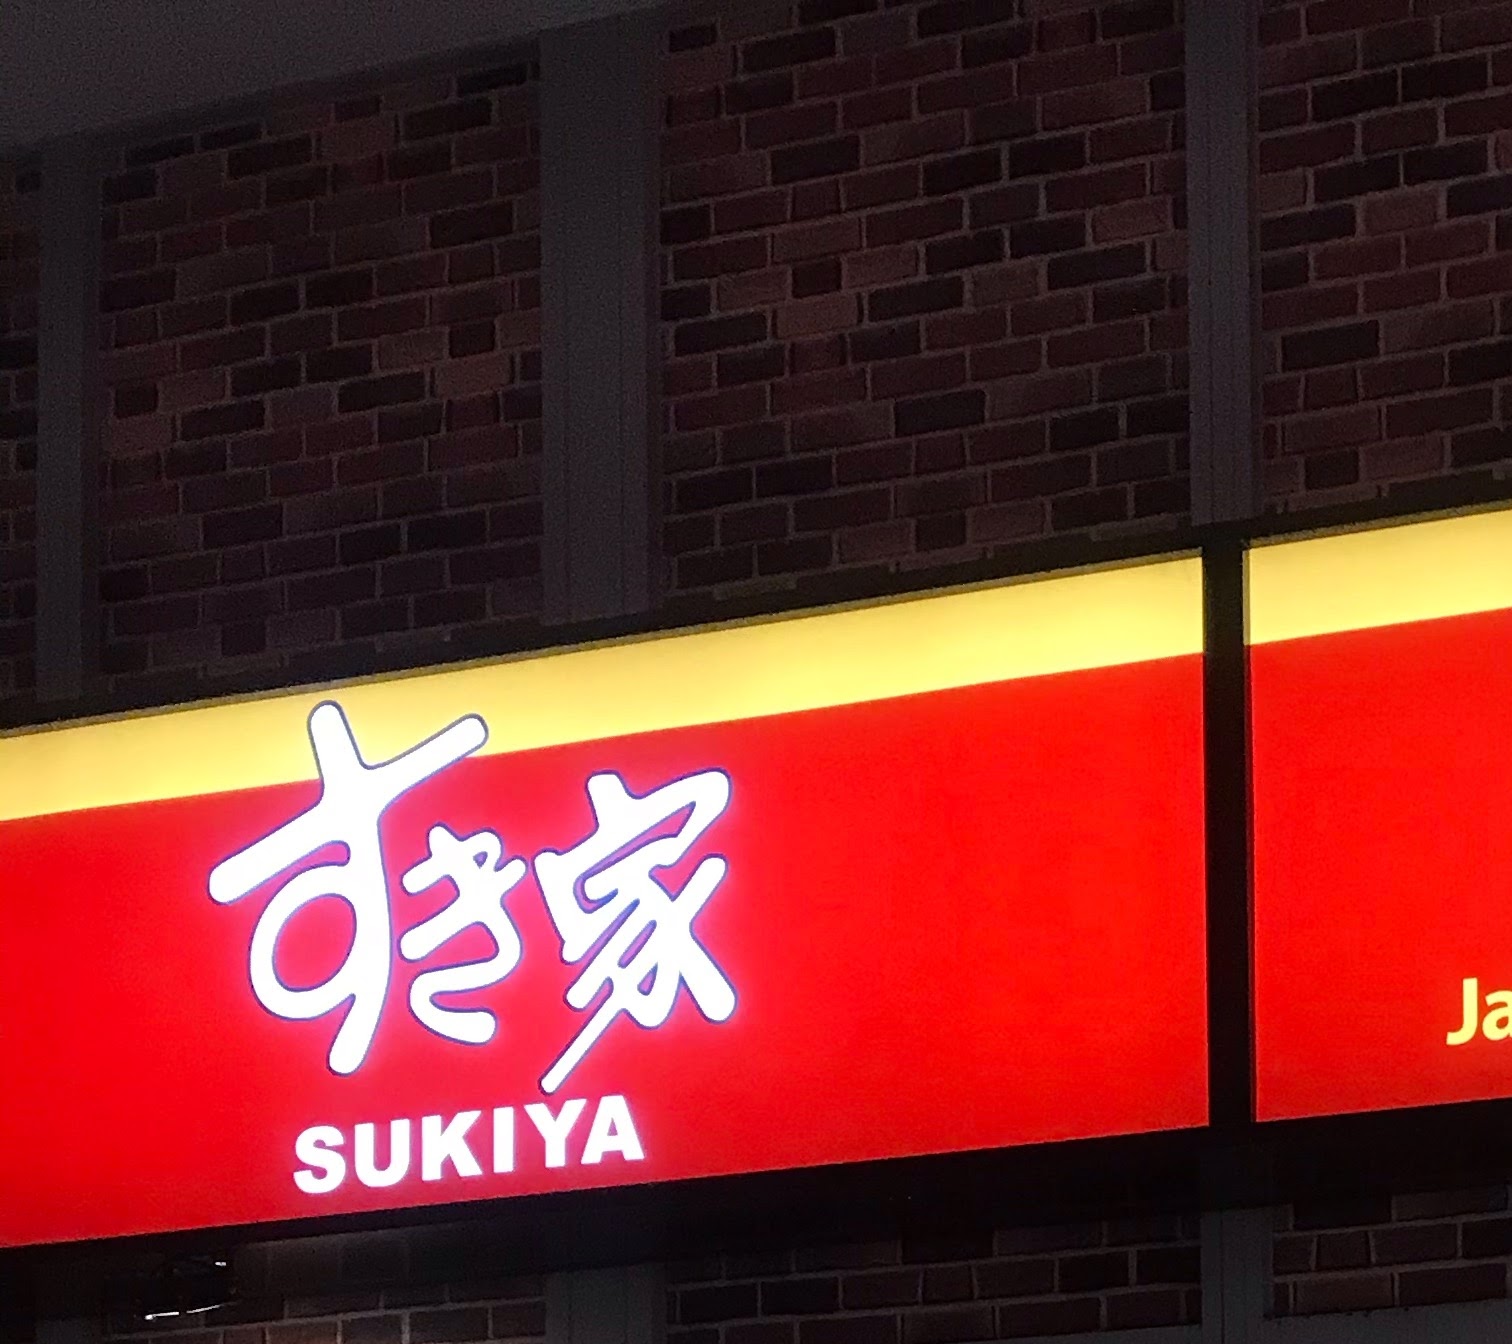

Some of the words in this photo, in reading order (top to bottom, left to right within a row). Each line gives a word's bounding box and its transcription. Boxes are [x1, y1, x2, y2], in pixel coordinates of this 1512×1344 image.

[209, 700, 736, 1094] すき家
[293, 1094, 644, 1194] SUKIYA
